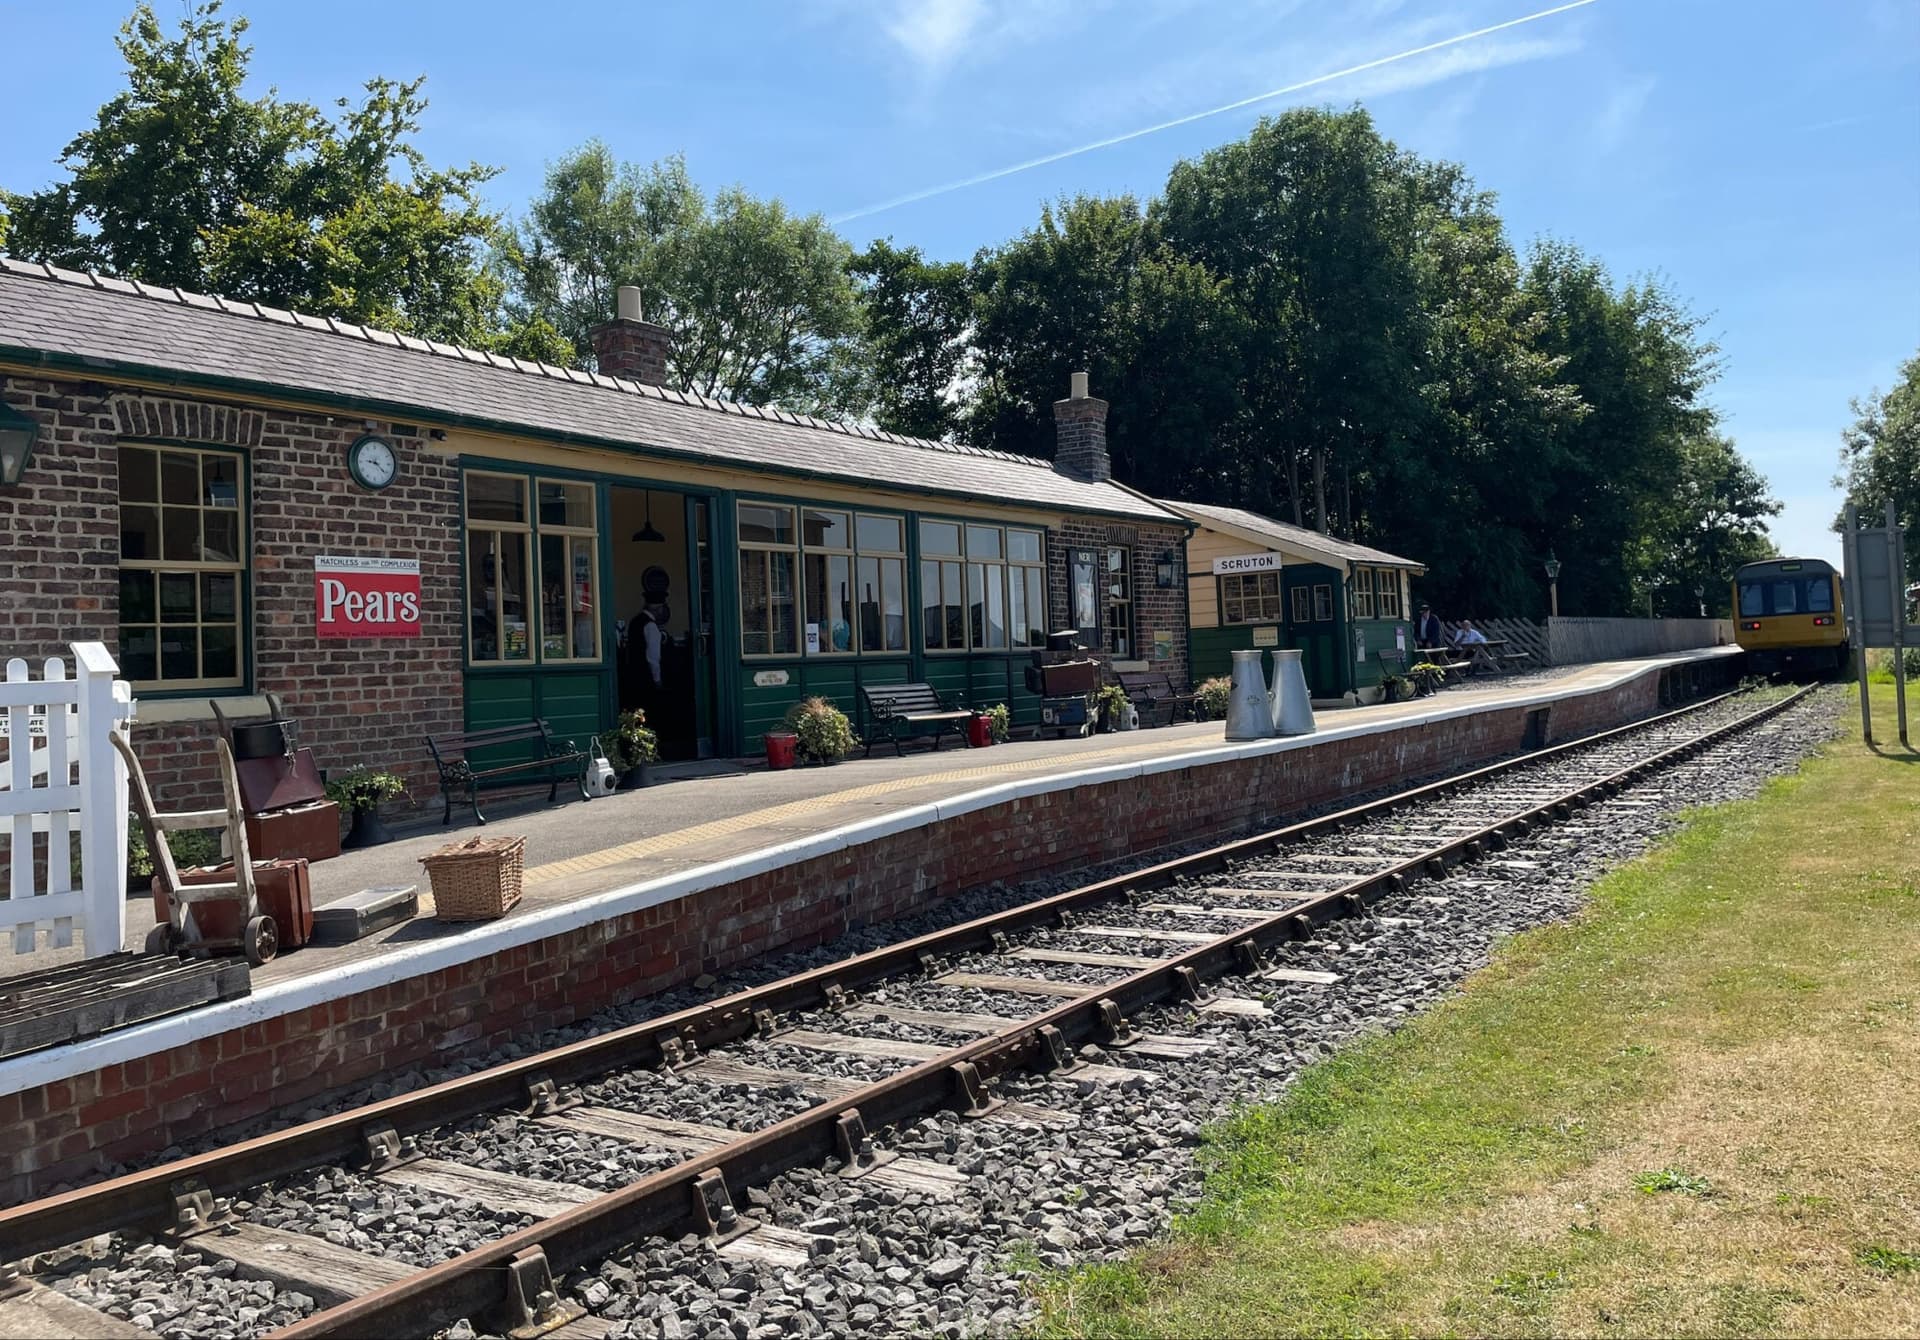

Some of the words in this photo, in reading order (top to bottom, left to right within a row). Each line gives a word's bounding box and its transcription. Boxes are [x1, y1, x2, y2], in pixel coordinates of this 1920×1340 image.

[320, 558, 359, 566] MATCHLESS
[380, 560, 417, 568] COMPLEXION
[1221, 556, 1273, 569] SCRUTON
[319, 579, 419, 622] Pears
